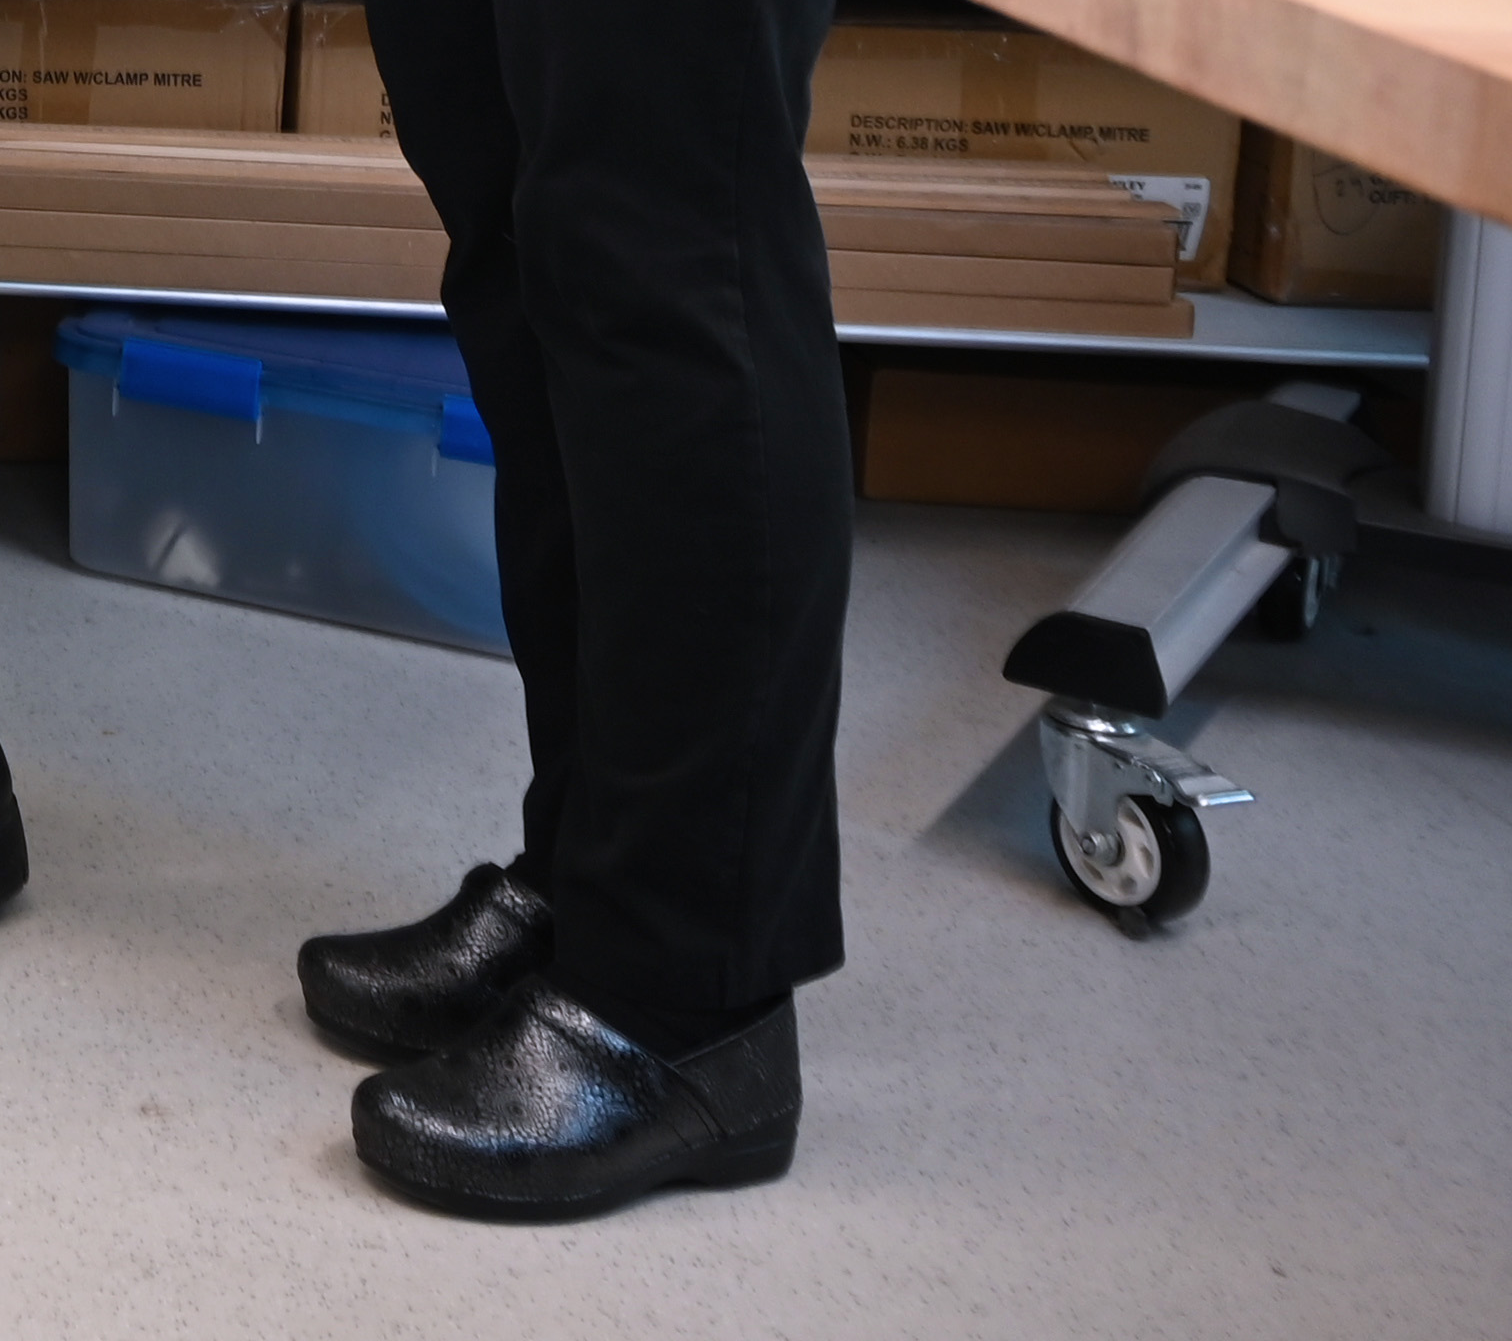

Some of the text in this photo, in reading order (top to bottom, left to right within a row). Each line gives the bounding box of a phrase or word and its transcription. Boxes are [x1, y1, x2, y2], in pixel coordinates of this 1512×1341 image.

[32, 70, 68, 84] SAW
[74, 71, 149, 86] W/CLAMP
[153, 73, 203, 87] MITRE
[850, 115, 967, 133] DESCRIPTION:
[971, 120, 1009, 136] SAW
[1098, 125, 1150, 142] MITRE
[849, 133, 969, 152] N.W.: 6.38 KGS
